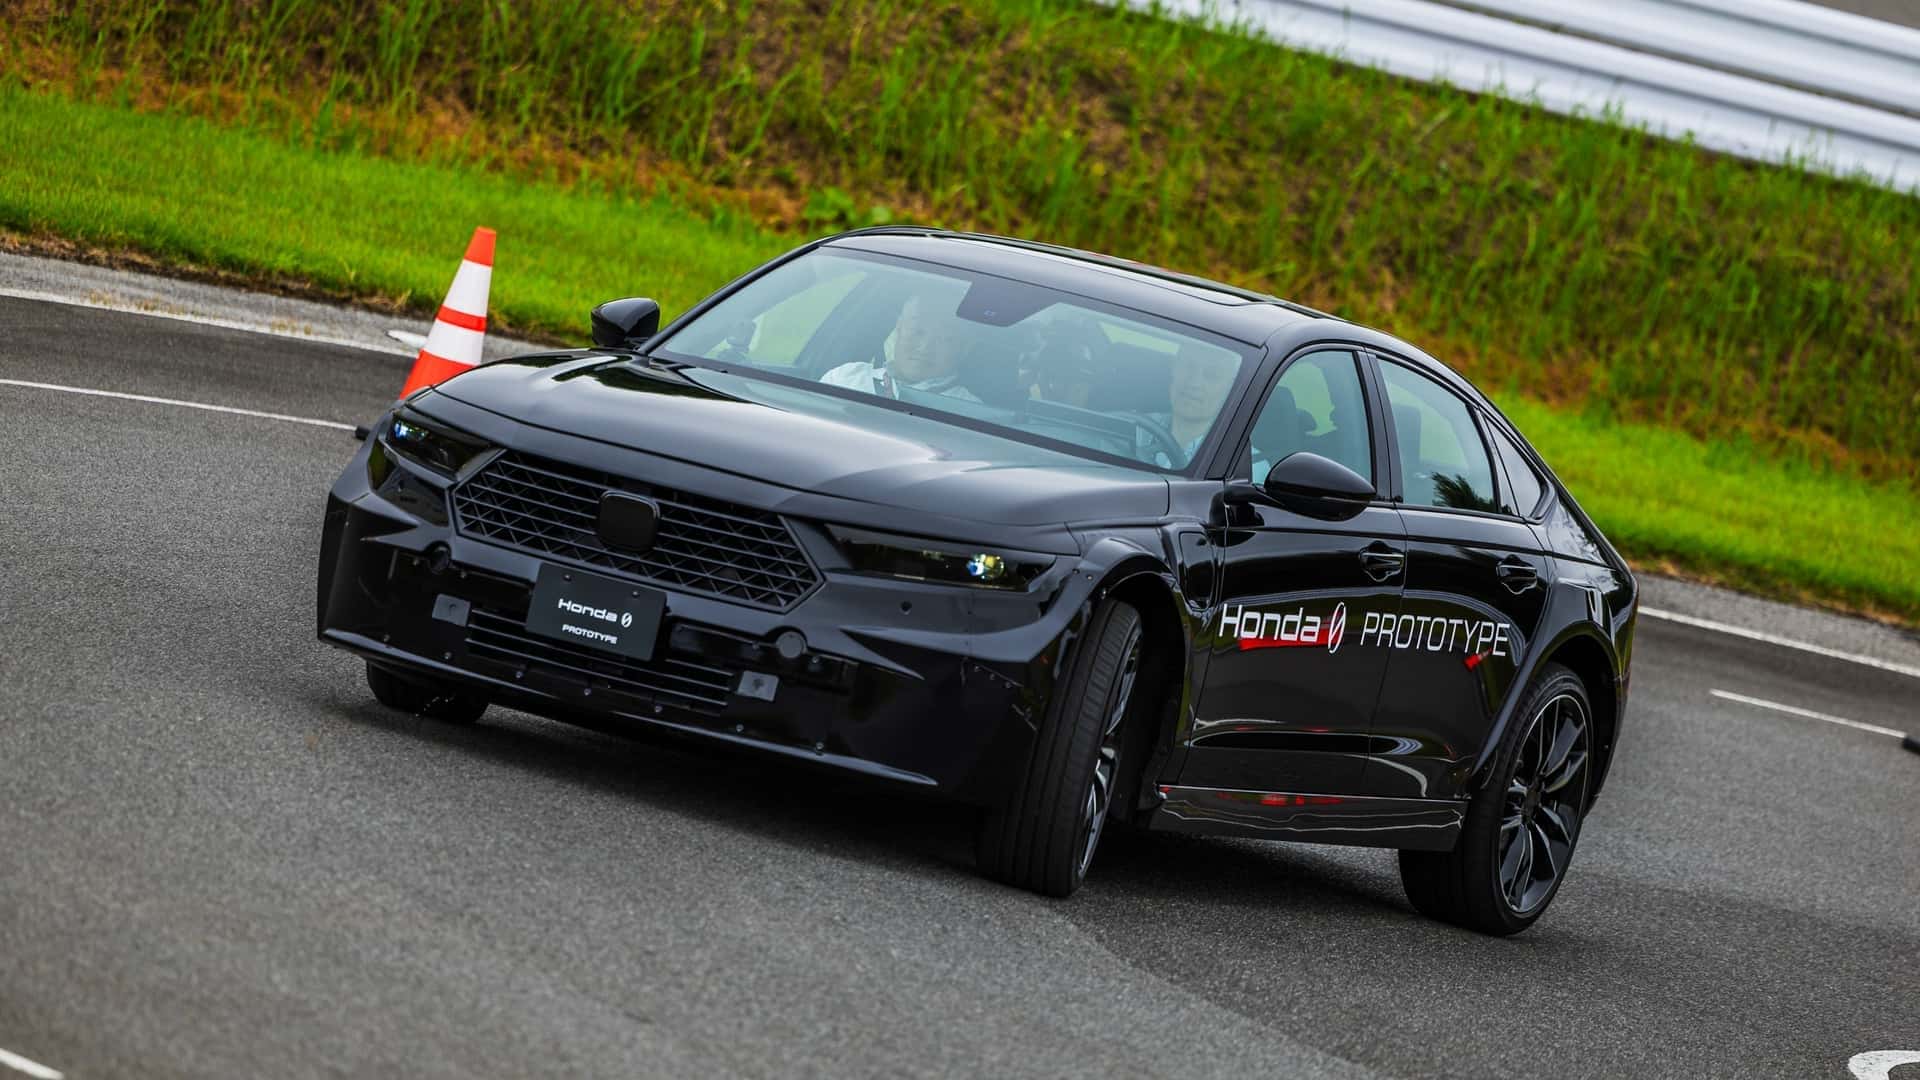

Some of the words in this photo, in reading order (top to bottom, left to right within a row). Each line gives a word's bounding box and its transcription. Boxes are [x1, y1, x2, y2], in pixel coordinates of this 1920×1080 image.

[558, 598, 618, 622] Honda
[562, 624, 618, 644] PROTOTYPE
[1218, 603, 1321, 642] Honda
[1360, 611, 1511, 657] PROTOTYPE
